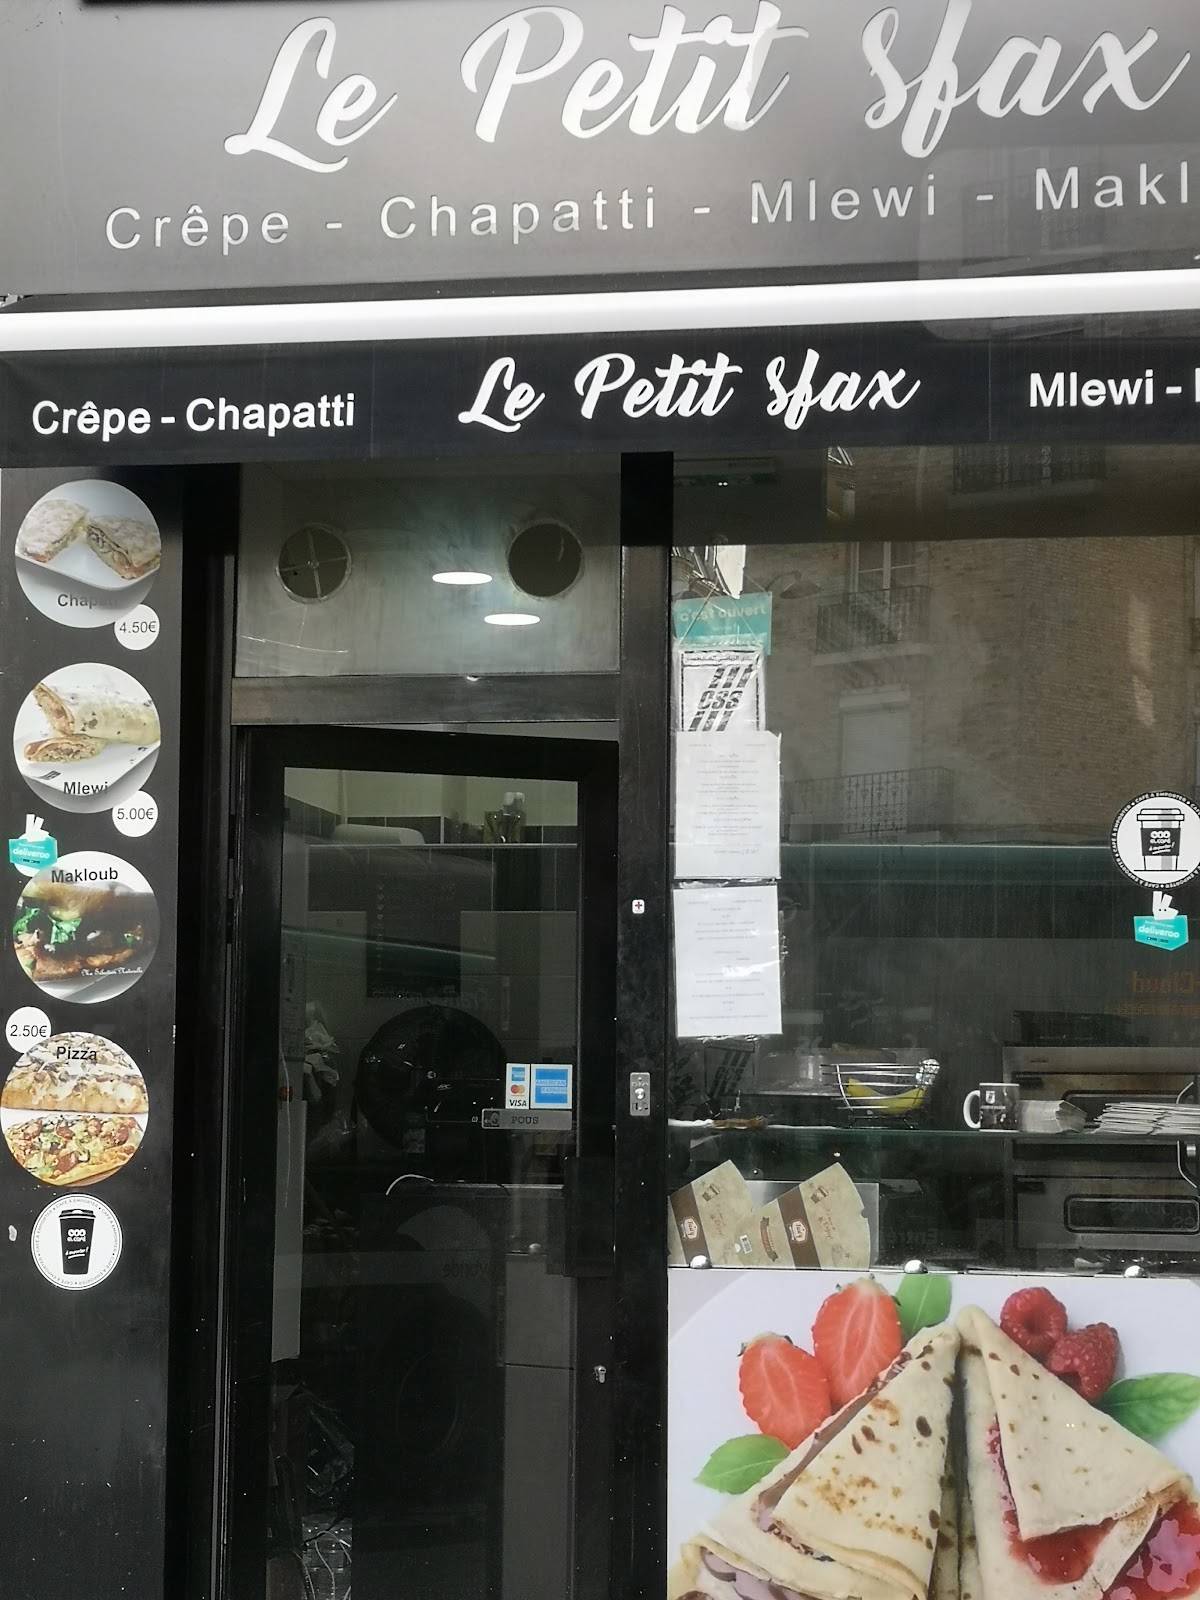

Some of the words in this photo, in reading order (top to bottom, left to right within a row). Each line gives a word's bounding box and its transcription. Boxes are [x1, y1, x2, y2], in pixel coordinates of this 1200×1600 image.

[225, 18, 398, 172] Le
[461, 1, 808, 142] Petit
[107, 206, 288, 255] Crêpe
[381, 187, 653, 244] Chapatti
[752, 174, 934, 224] Mlewi
[1036, 162, 1187, 210] Makl
[458, 357, 545, 432] Le
[575, 353, 742, 419] Petit
[1030, 369, 1153, 407] Mlewi
[33, 401, 150, 442] Crêpe
[187, 393, 354, 436] Chapatti
[119, 620, 157, 633] 4.50€
[63, 781, 108, 795] Mlewi
[117, 807, 154, 820] 5.00€
[51, 867, 118, 884] Makloub
[10, 1024, 47, 1038] 2.50€
[56, 1046, 98, 1061] Pizza
[509, 1099, 527, 1107] VISA
